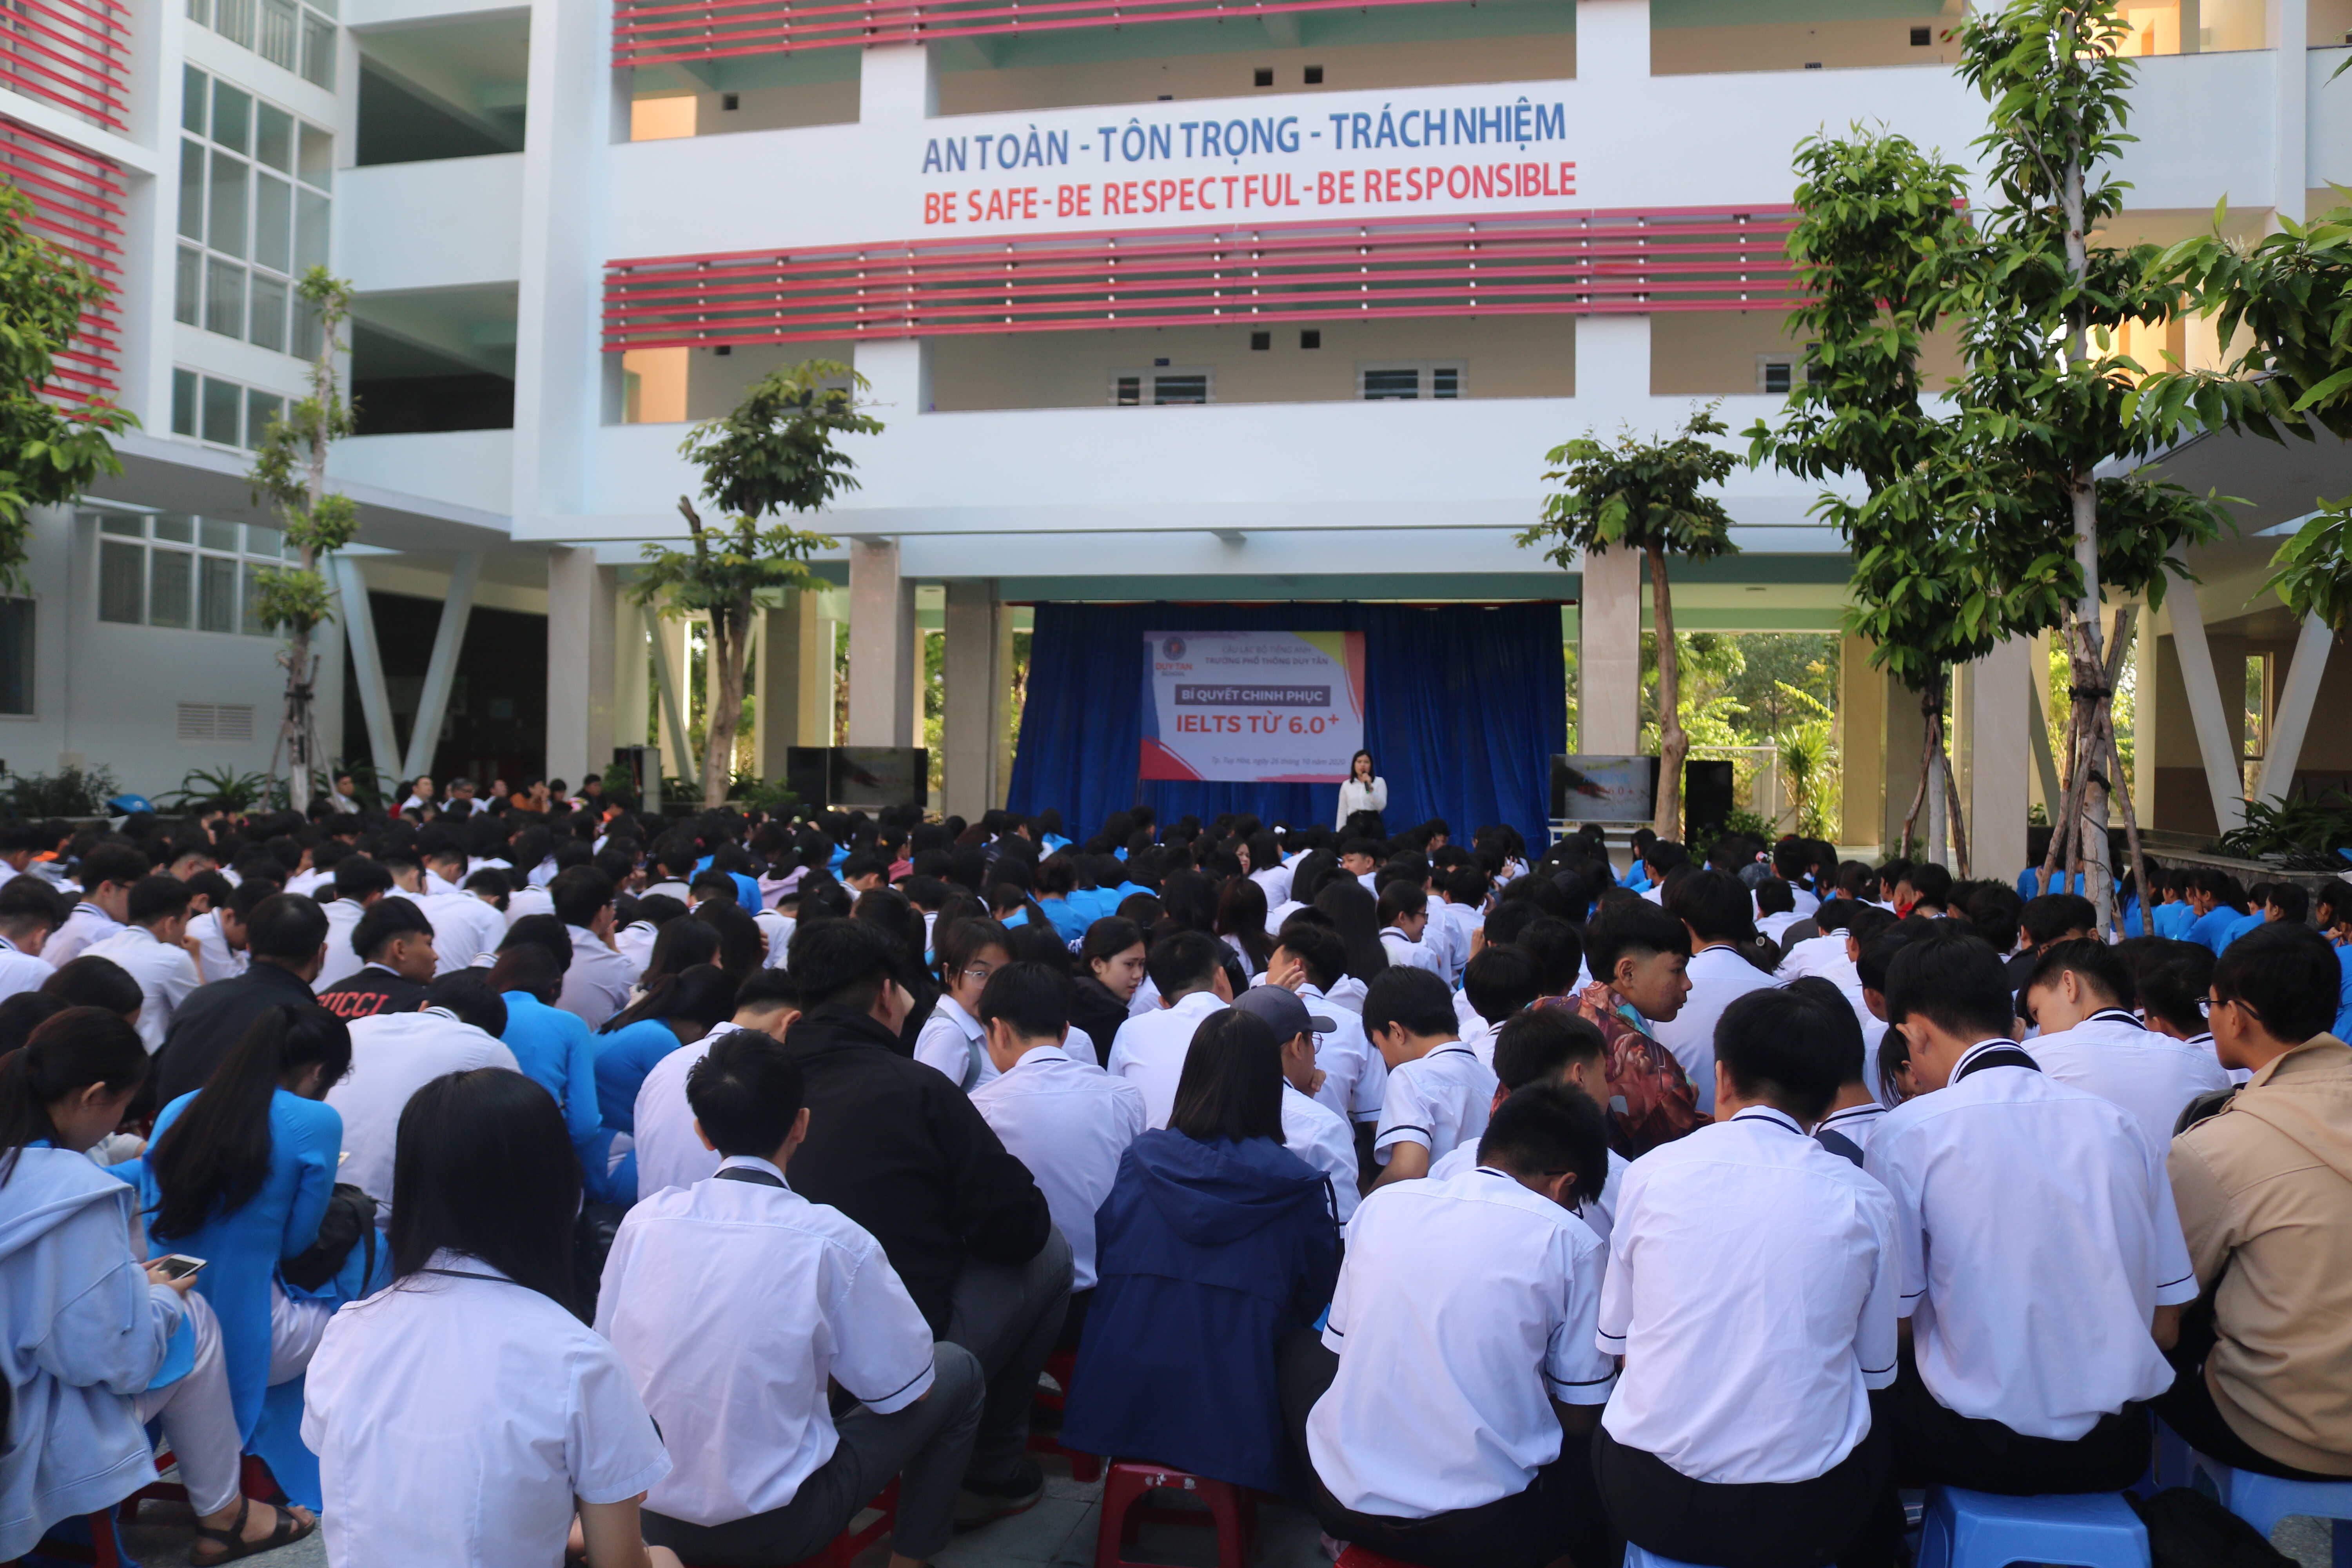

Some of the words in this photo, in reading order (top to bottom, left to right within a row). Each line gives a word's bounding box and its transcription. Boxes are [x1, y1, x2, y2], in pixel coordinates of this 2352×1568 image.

[923, 137, 967, 173] AN
[975, 123, 1069, 170] TOÀN
[1098, 117, 1171, 162] TÔN
[1179, 116, 1300, 165] TRỌNG
[924, 192, 956, 224] BE
[1364, 162, 1576, 203] RESPONSIBLE
[1181, 687, 1194, 700] BÍ
[1197, 687, 1239, 702] QUYẾT
[1241, 690, 1284, 701] CHINH
[1286, 691, 1323, 704] PHỤC
[1176, 715, 1241, 733] IELTS
[1246, 710, 1283, 734] TỪ
